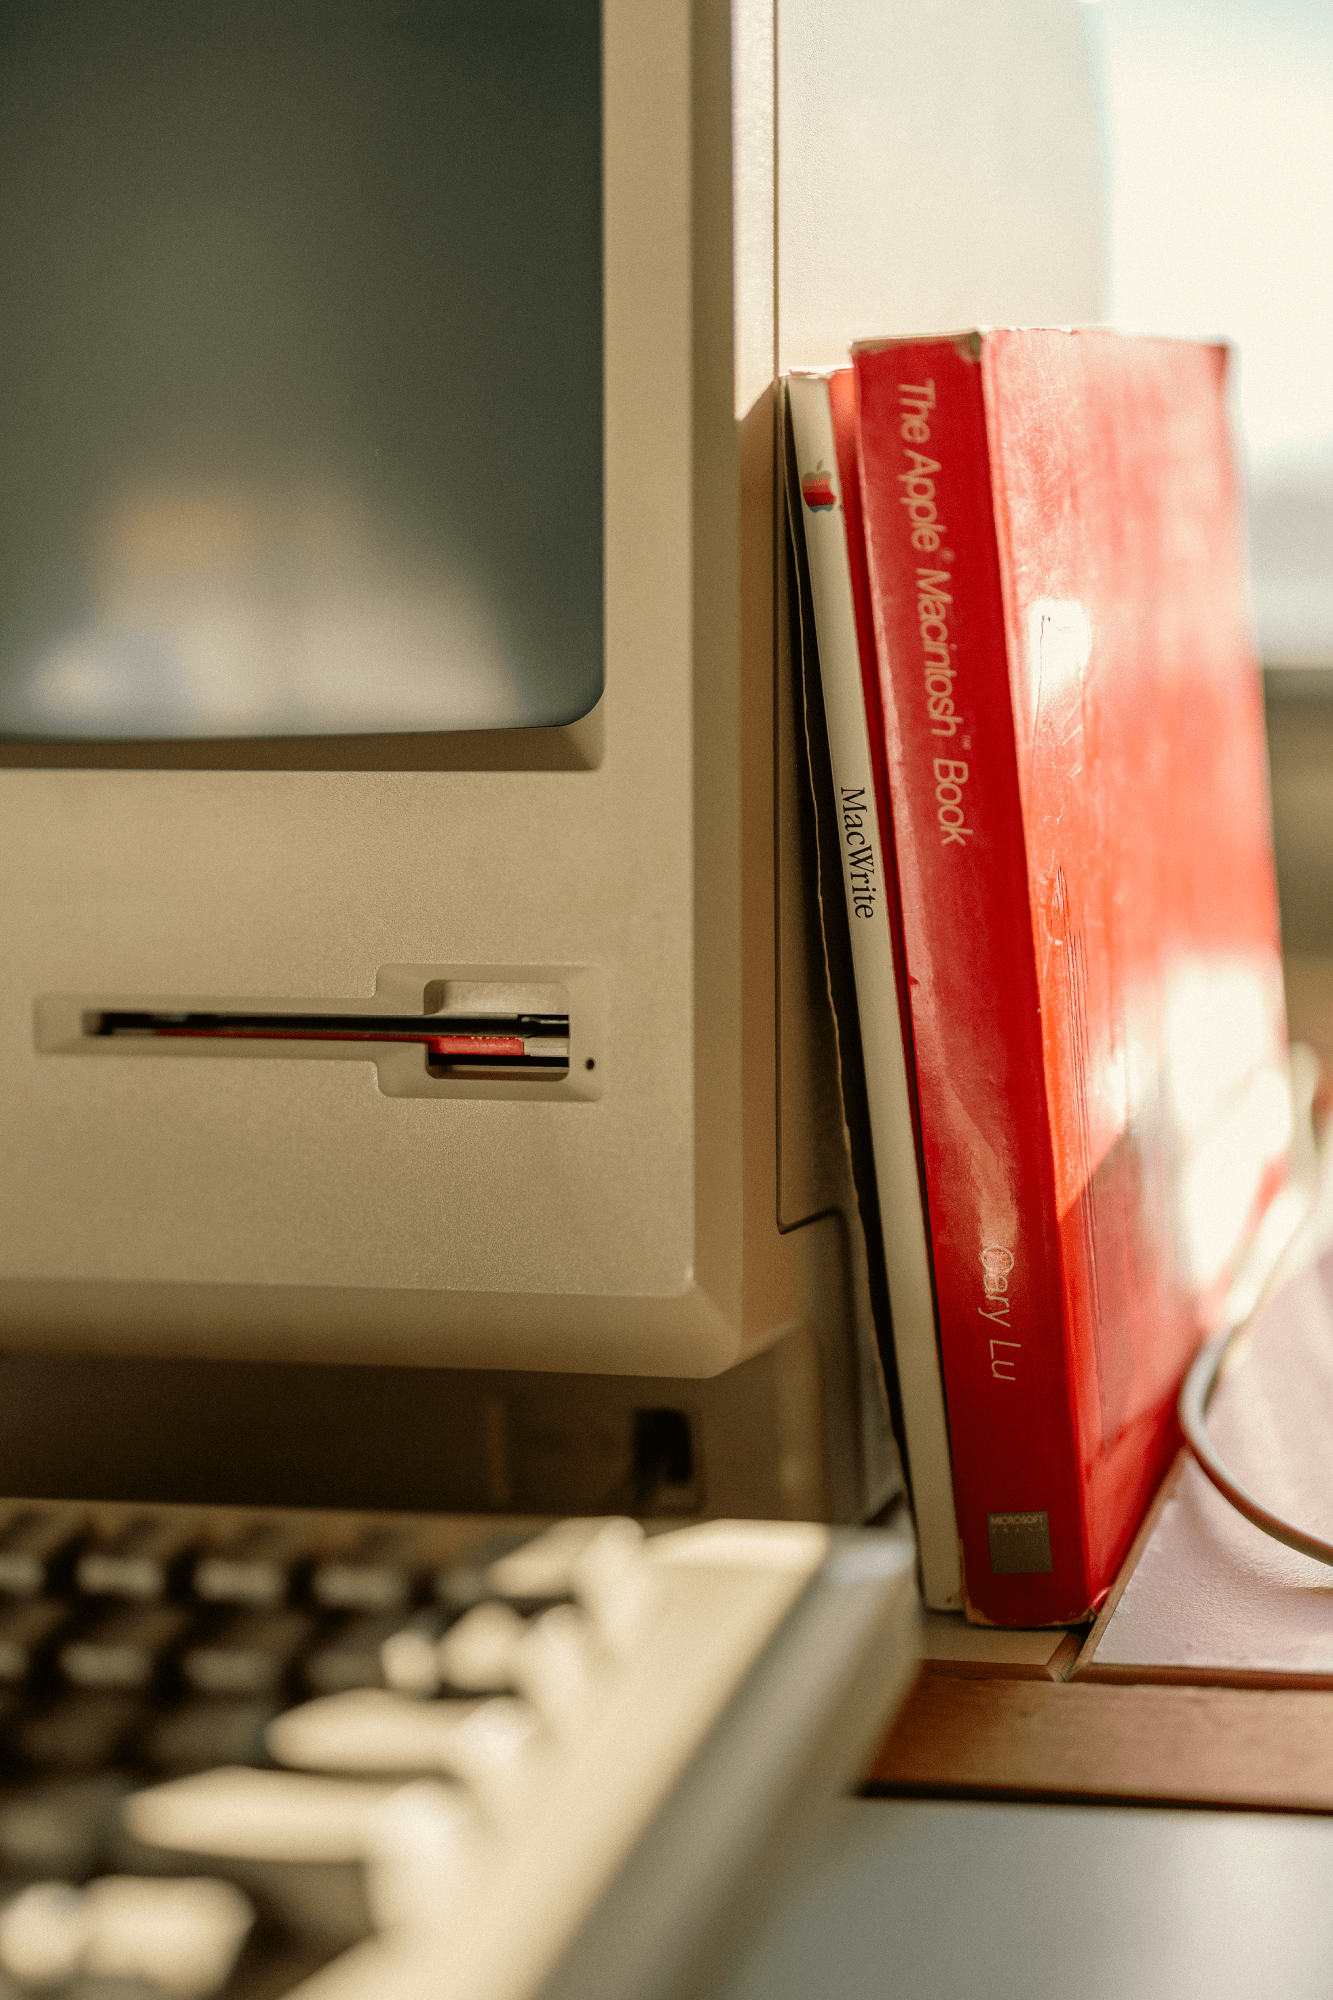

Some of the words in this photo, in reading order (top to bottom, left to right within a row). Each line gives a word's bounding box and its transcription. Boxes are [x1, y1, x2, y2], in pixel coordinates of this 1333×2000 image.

[898, 377, 936, 444] The
[932, 757, 974, 846] Book
[840, 786, 876, 918] MacWrite
[978, 1245, 1015, 1328] Gary
[989, 1339, 1022, 1381] Lu
[990, 1514, 1044, 1525] MICROSOFT
